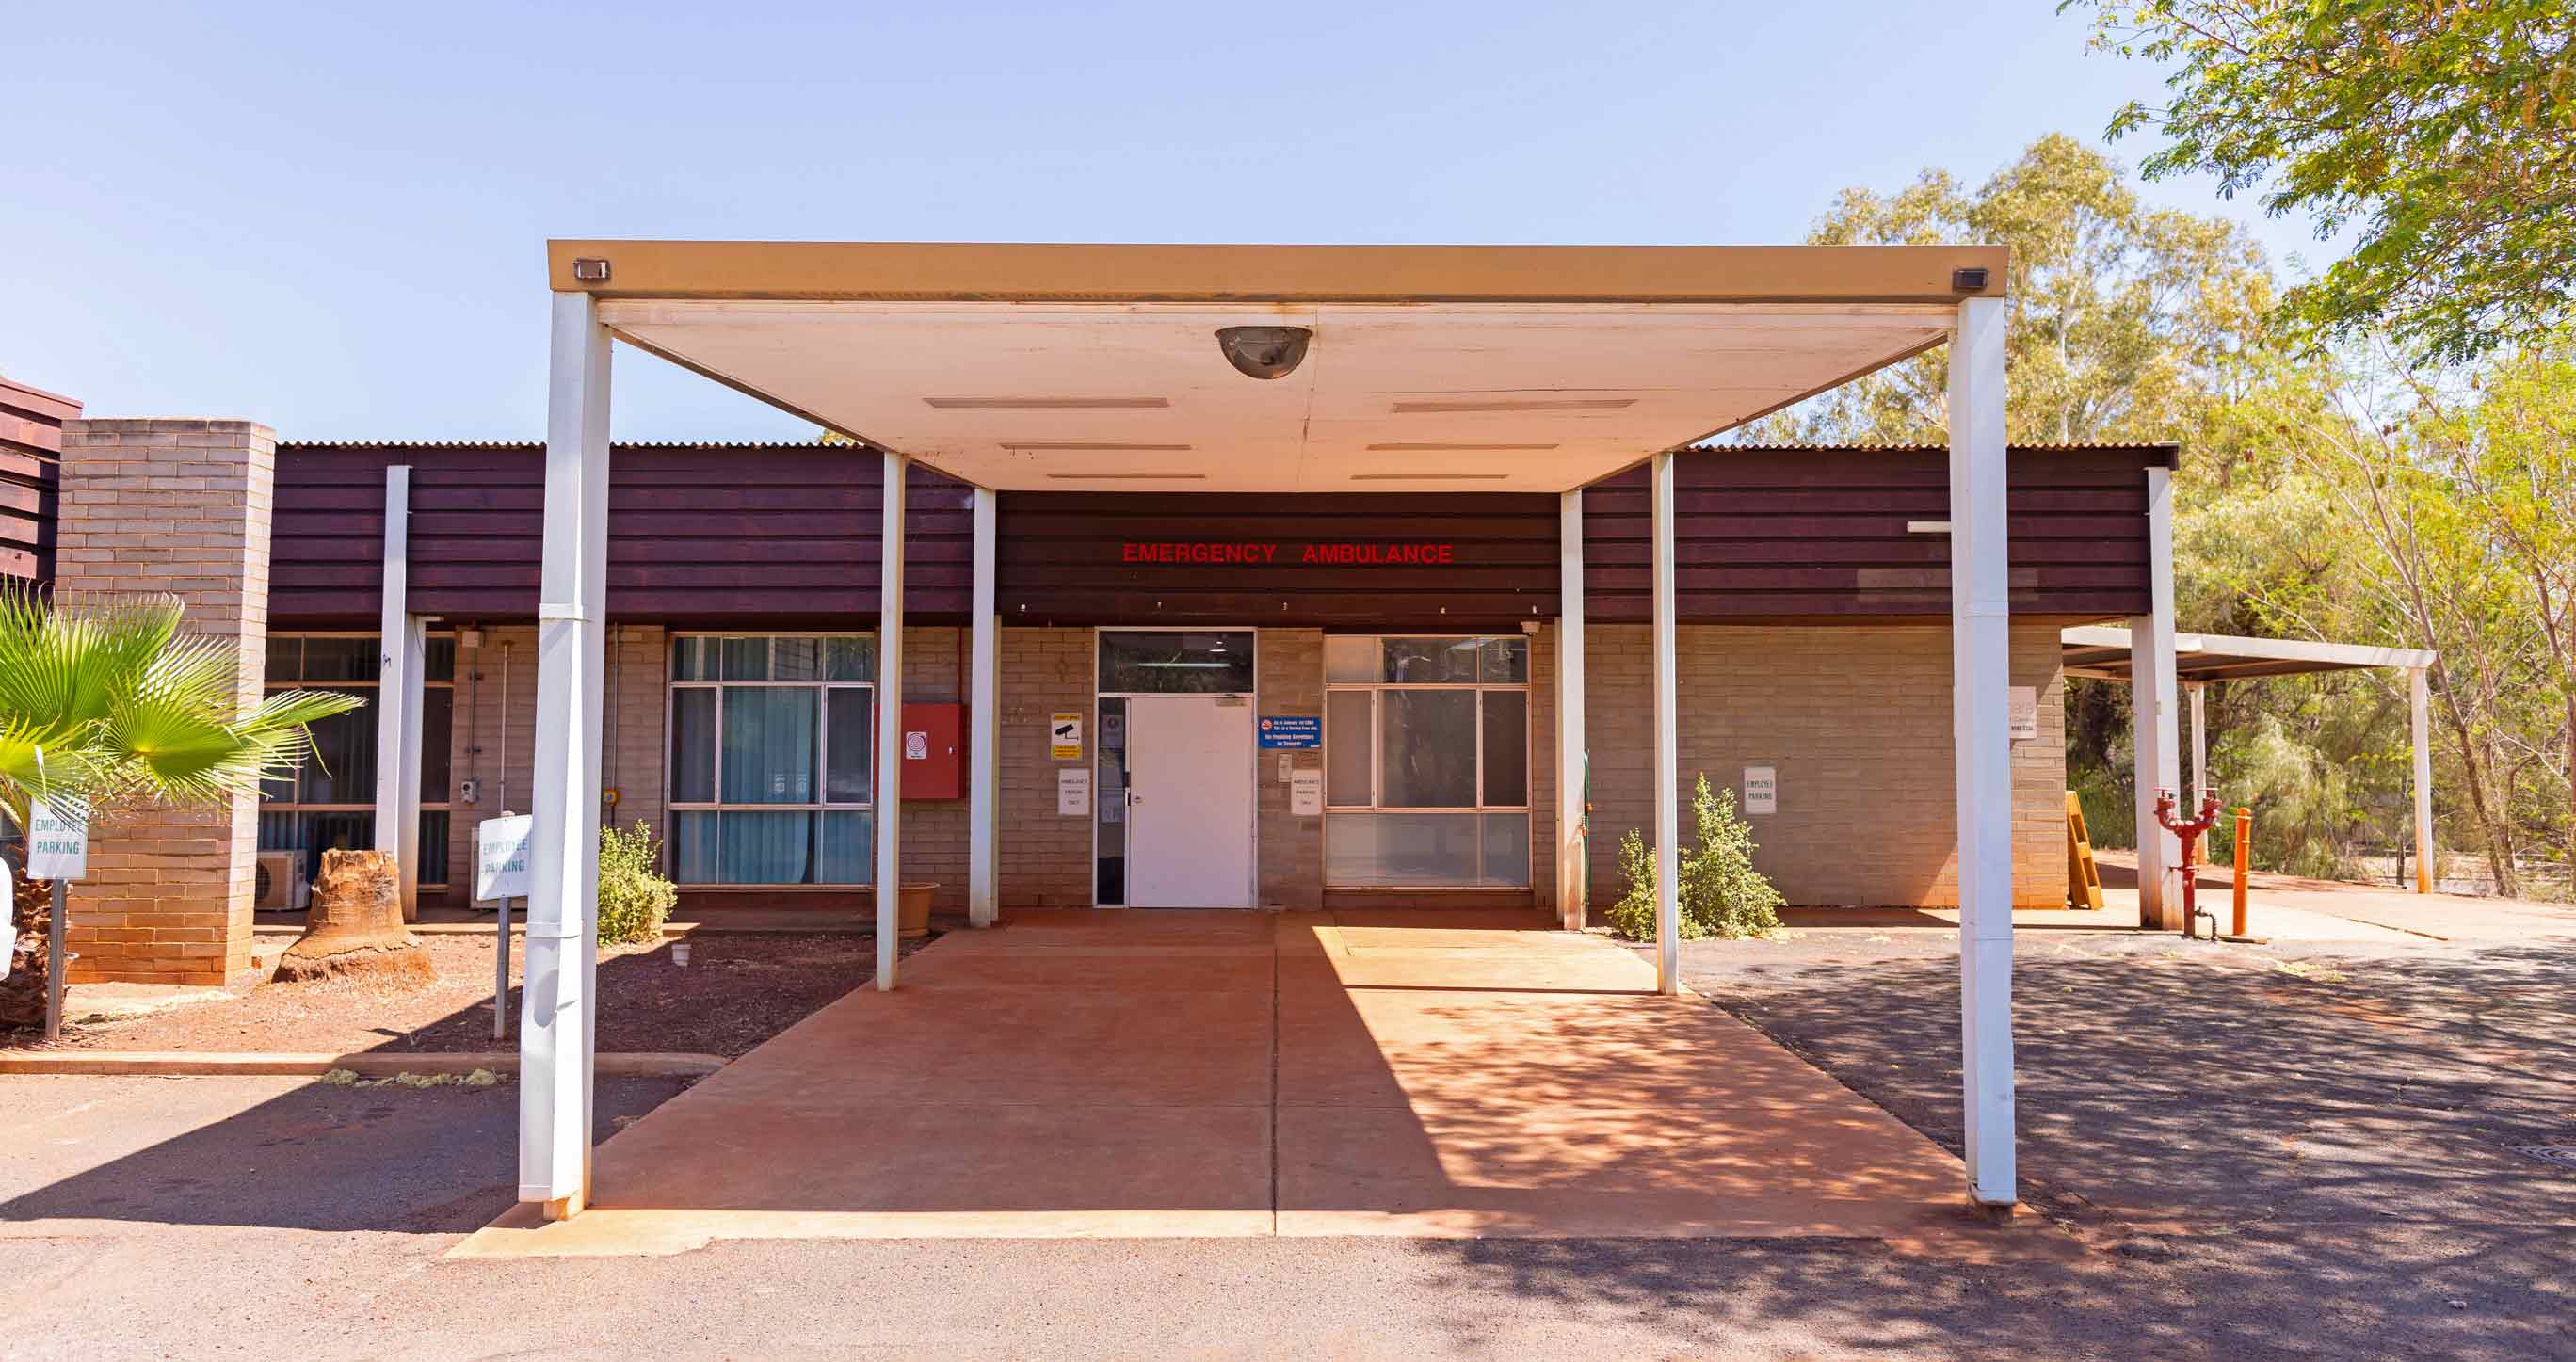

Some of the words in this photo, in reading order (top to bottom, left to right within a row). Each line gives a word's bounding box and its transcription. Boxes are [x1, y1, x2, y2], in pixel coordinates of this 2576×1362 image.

[1122, 542, 1278, 563] EMERGENCY
[1302, 543, 1454, 564] AMBULANCE
[37, 841, 80, 856] PARKING
[483, 837, 529, 853] EMPLOYEE
[485, 858, 525, 874] PARKING
